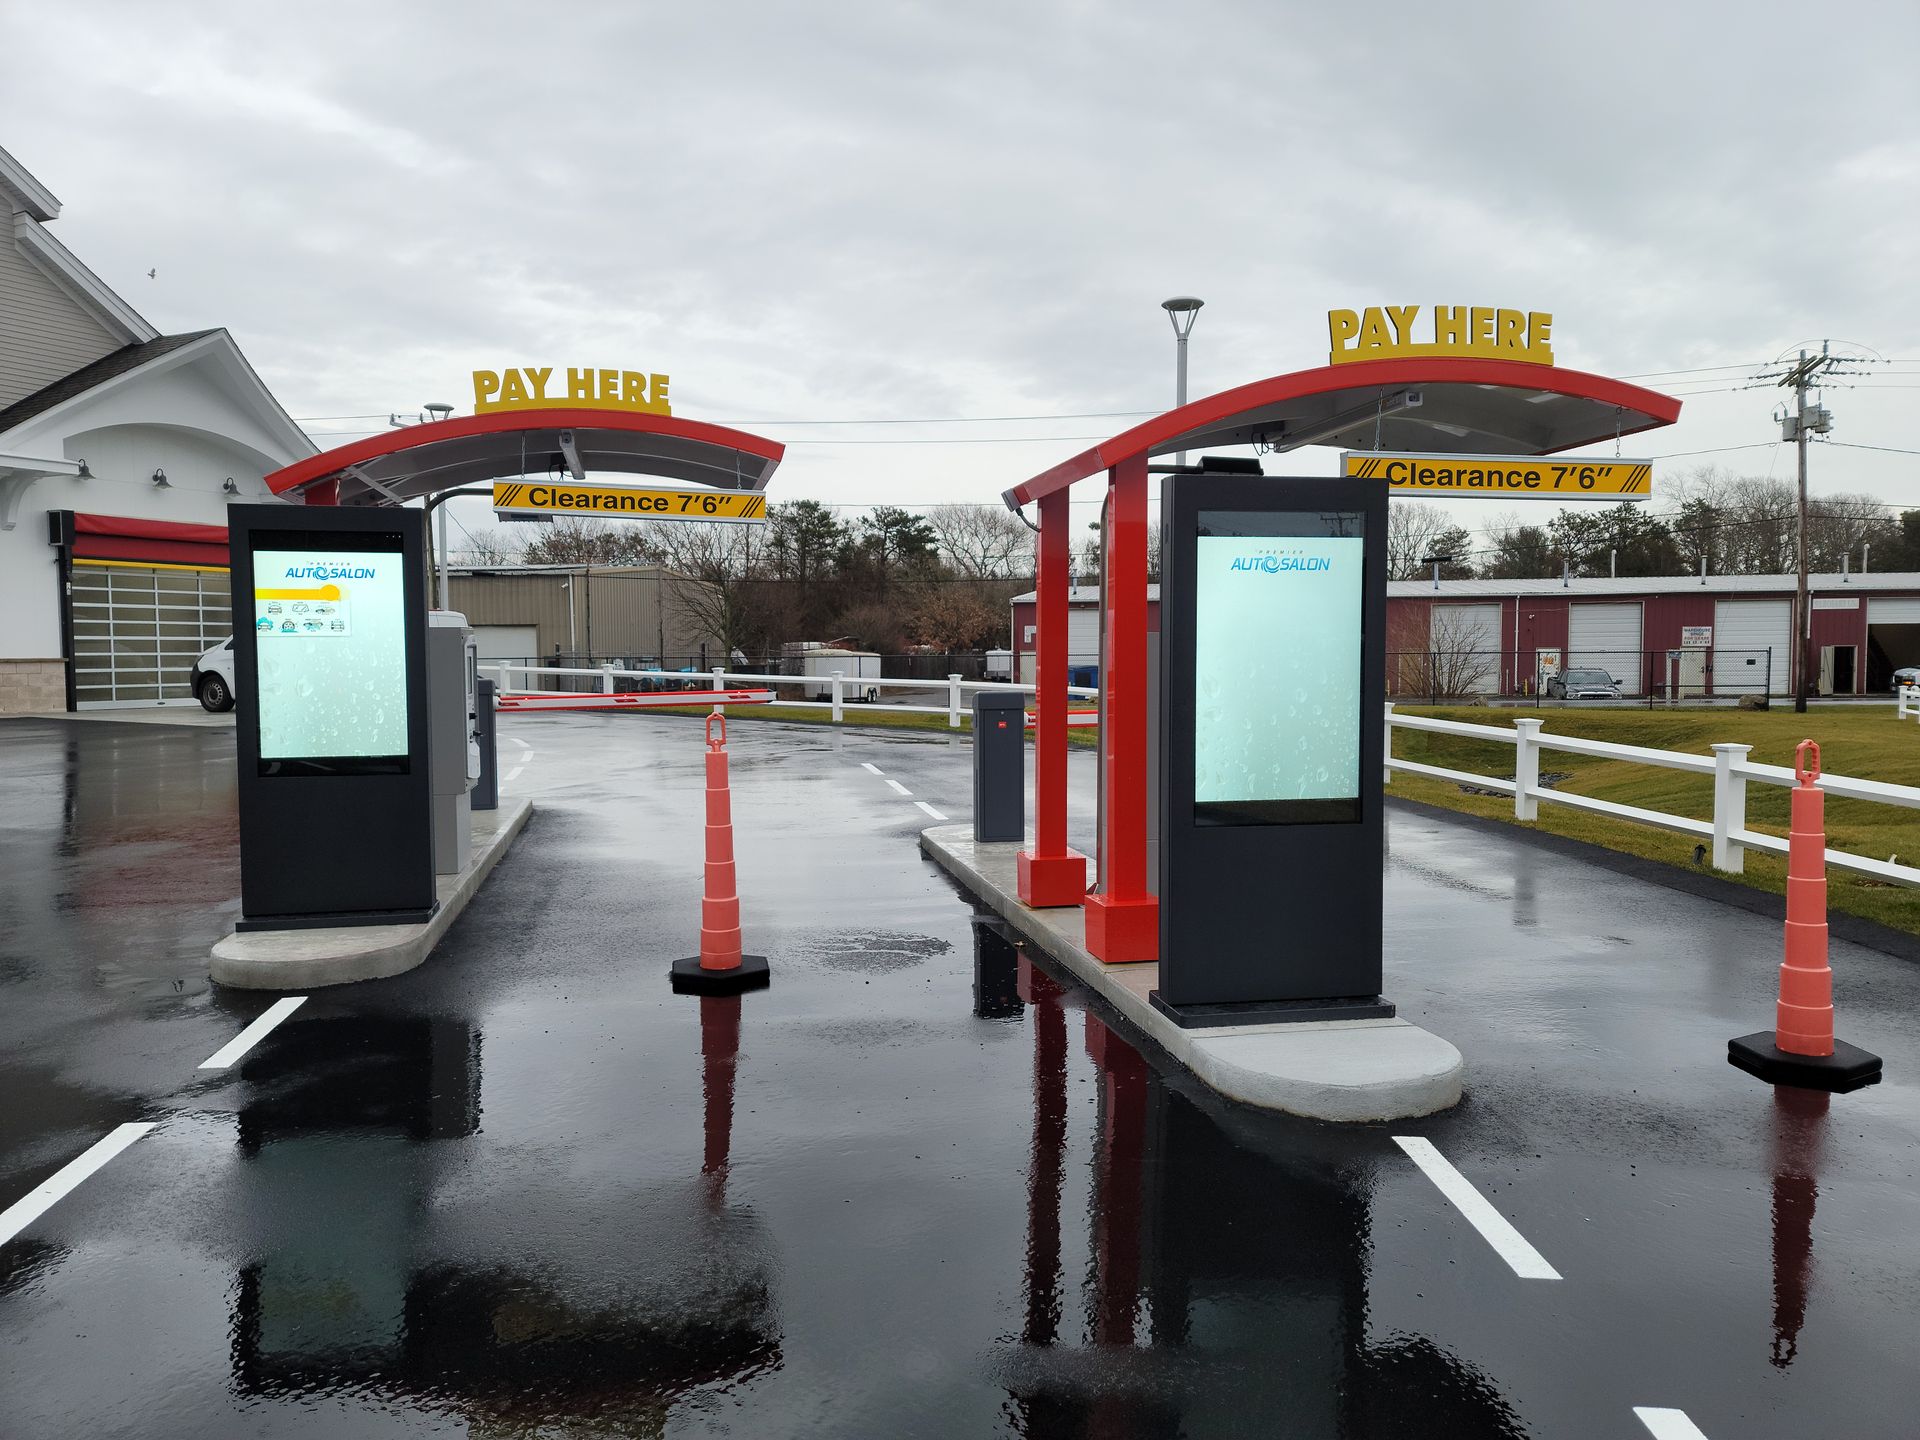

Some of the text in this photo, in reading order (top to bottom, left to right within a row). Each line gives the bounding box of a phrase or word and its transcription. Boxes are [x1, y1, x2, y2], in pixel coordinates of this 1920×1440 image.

[1328, 305, 1553, 351] PAY HERE
[472, 367, 670, 404] PAY HERE
[1385, 462, 1541, 489] Clearance
[528, 487, 669, 512] Clearance
